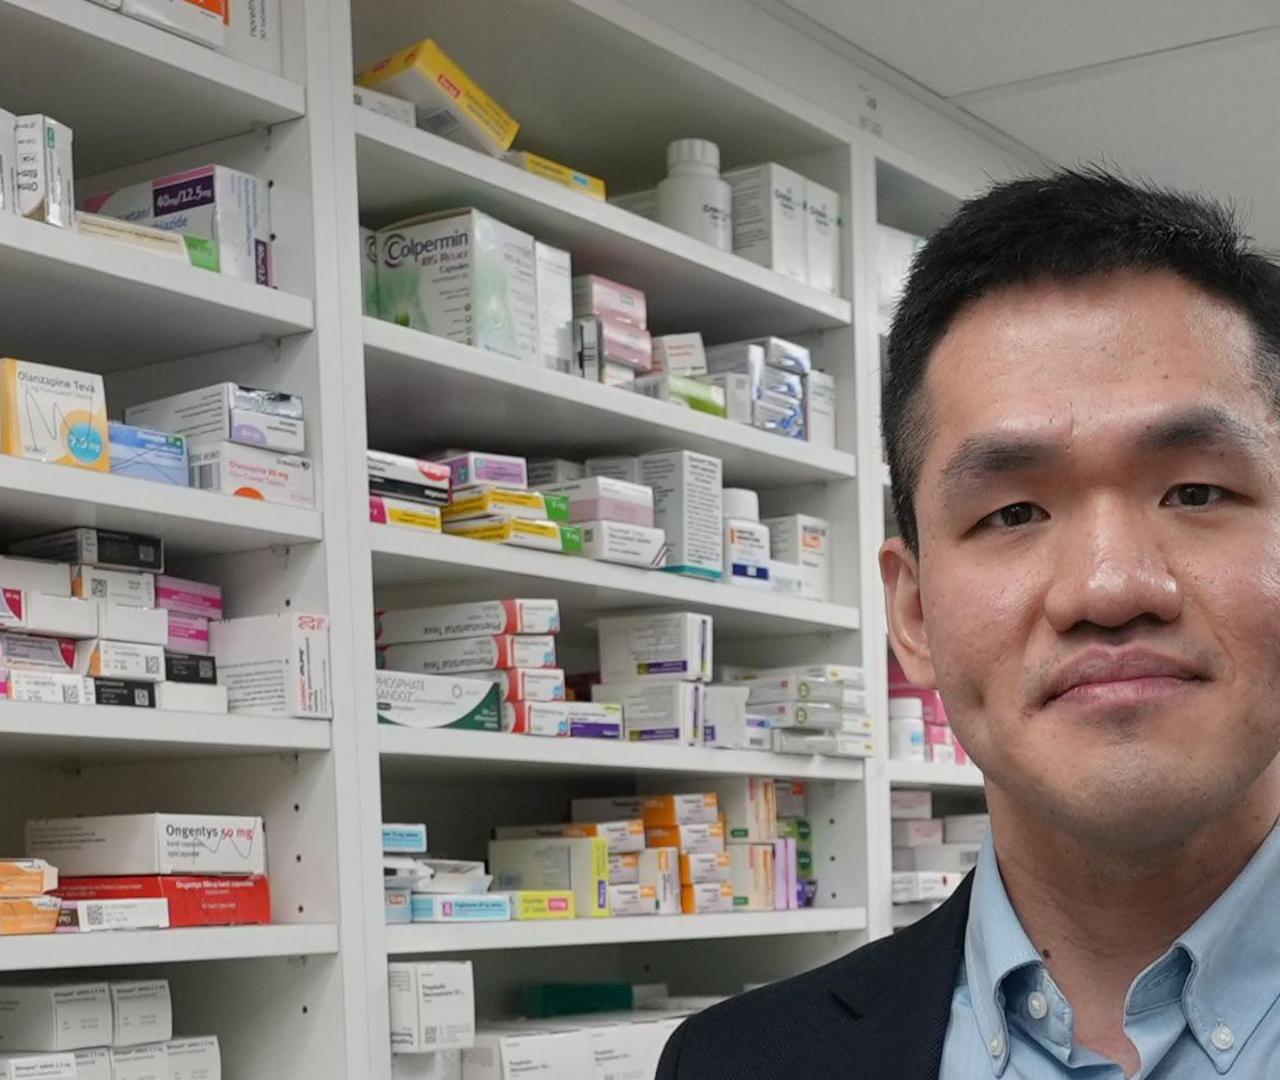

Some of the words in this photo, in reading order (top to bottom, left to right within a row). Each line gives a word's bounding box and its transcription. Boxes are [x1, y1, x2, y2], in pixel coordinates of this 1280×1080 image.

[385, 231, 469, 264] Colpermin
[18, 371, 71, 389] Olanzapine
[73, 379, 96, 393] Teva
[166, 824, 218, 839] Ongentys
[221, 827, 234, 838] 50
